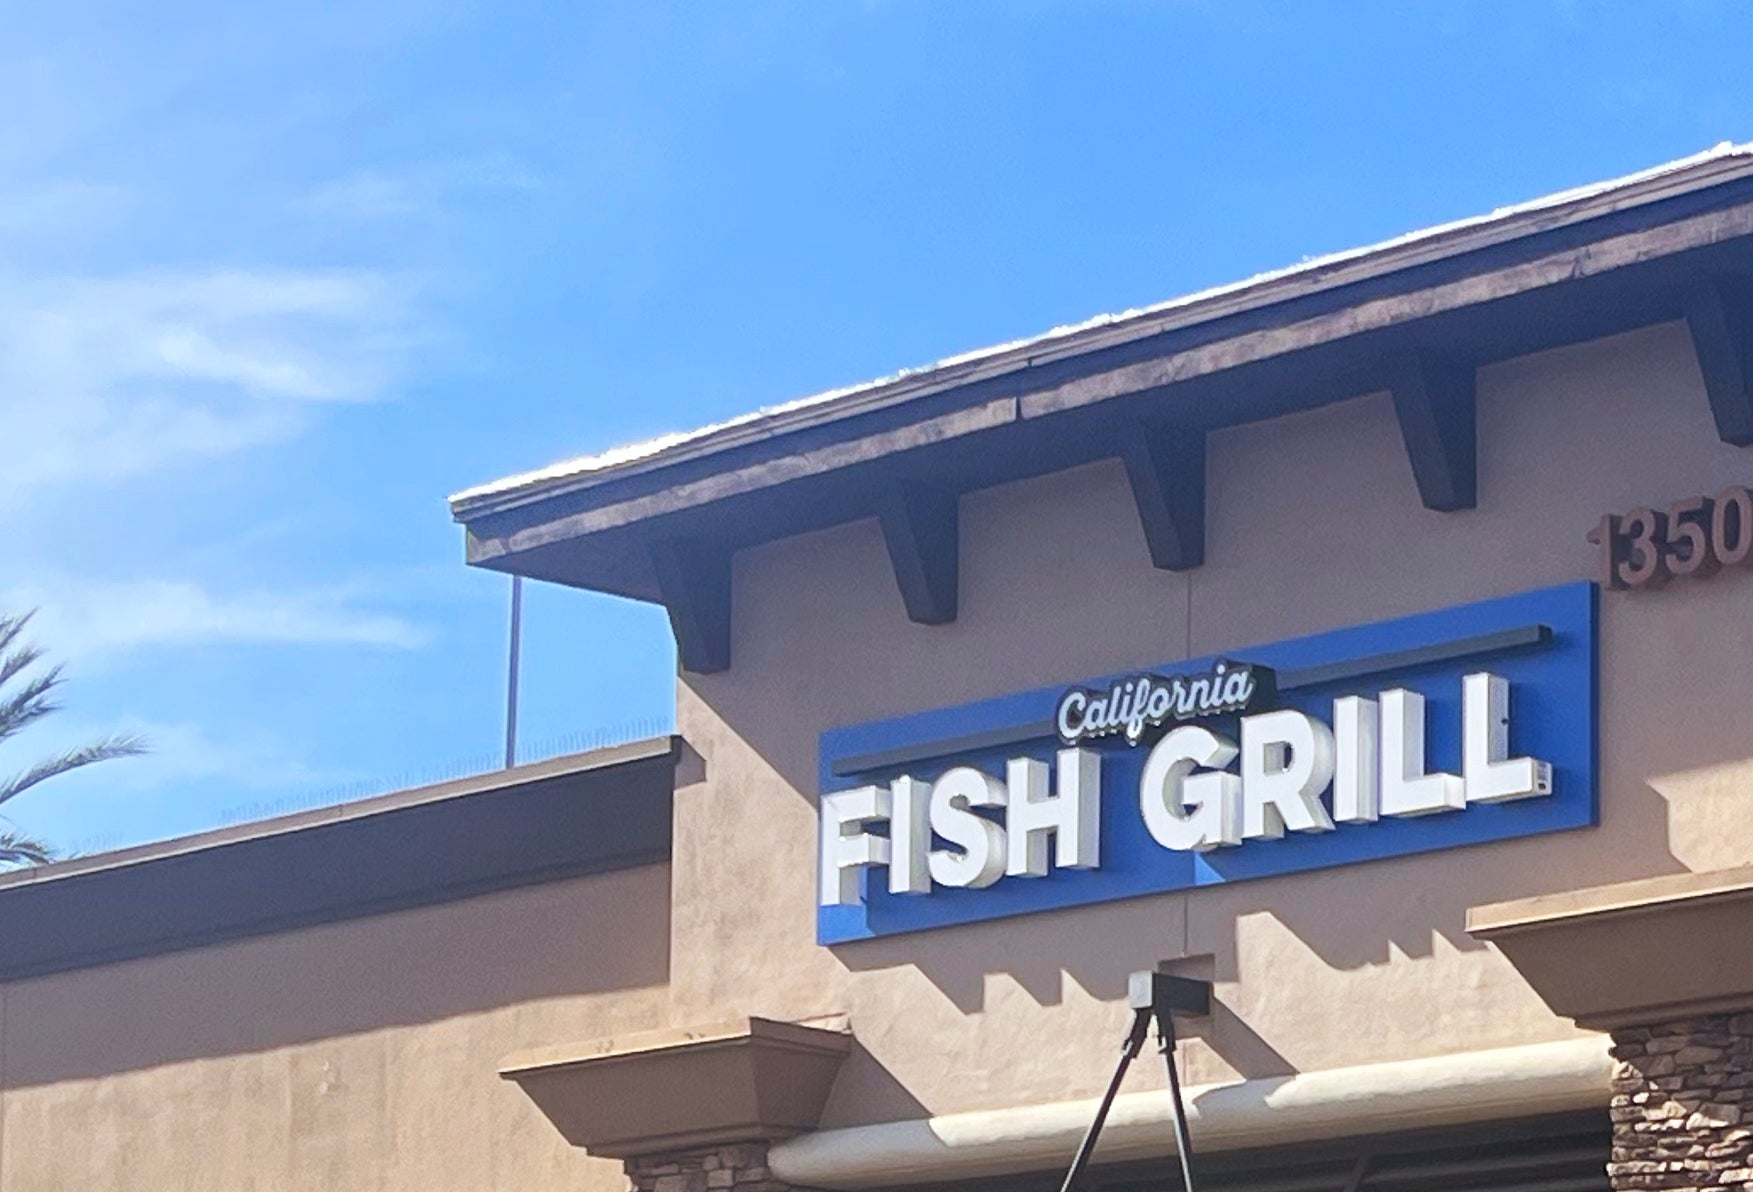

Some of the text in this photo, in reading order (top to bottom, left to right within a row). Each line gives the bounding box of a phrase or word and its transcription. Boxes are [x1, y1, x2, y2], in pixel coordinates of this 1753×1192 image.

[1058, 660, 1254, 745] California
[819, 672, 1554, 908] FISH GRILL
